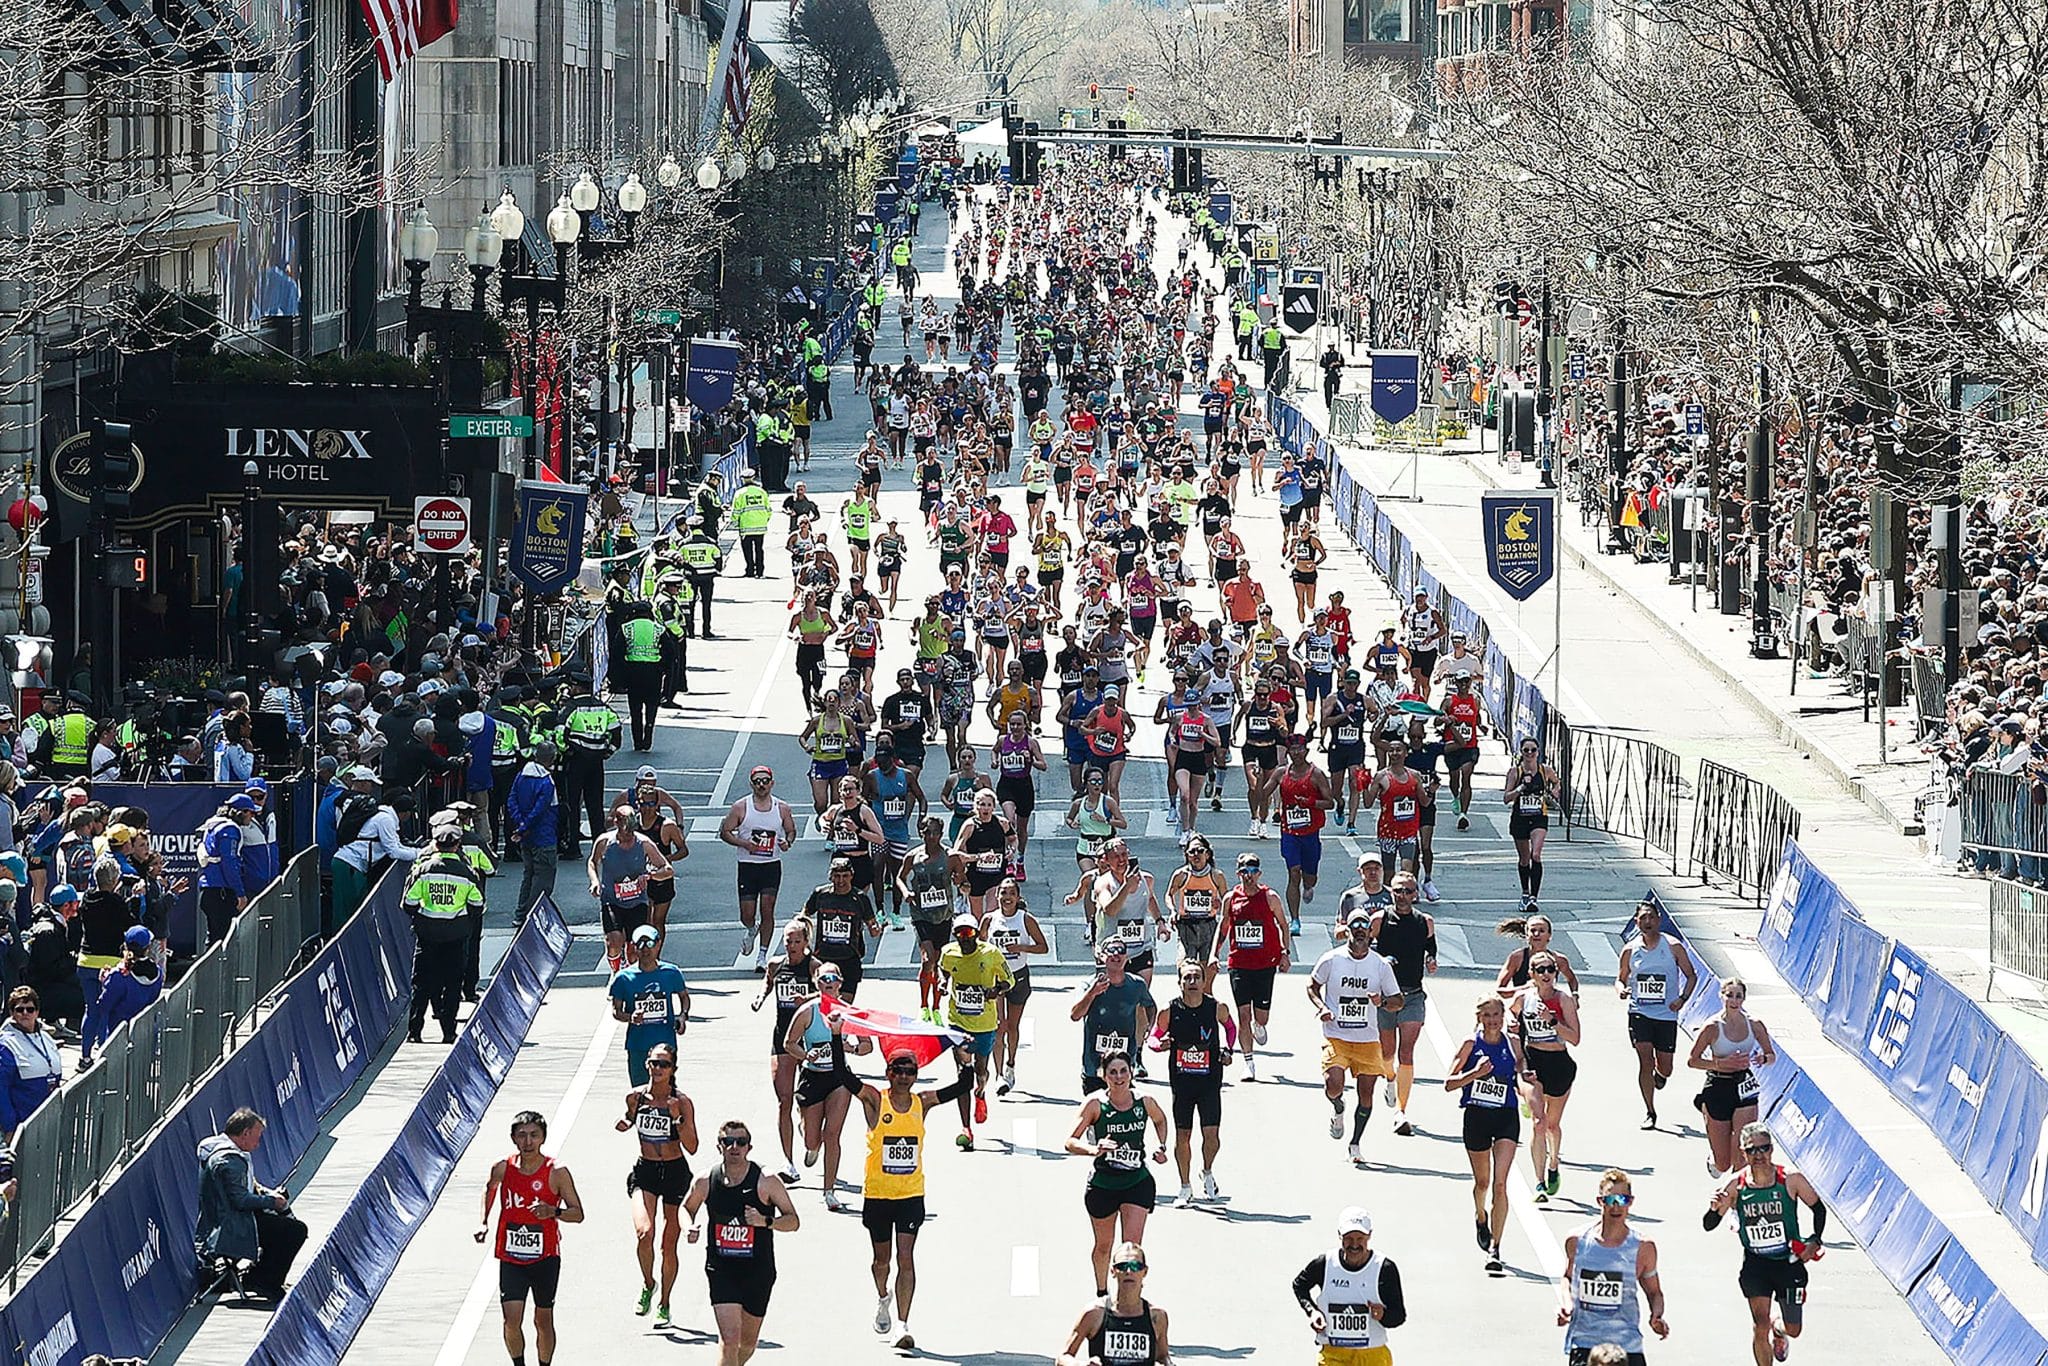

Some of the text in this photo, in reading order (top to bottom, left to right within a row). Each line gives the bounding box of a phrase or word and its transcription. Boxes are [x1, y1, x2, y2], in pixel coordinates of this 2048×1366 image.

[467, 420, 523, 436] EXETER ST
[268, 464, 330, 482] HOTEL
[424, 510, 461, 520] DO NOT
[427, 531, 457, 540] ENTER
[528, 535, 568, 548] BOSTON
[526, 545, 567, 554] MARATHON
[1498, 543, 1538, 553] BOSTON
[1498, 552, 1538, 560] MARATHON
[135, 557, 146, 582] 9
[429, 883, 457, 894] BOSTON
[431, 894, 455, 905] POLICE
[1236, 926, 1260, 937] 11232
[1640, 982, 1664, 993] 11632
[637, 1000, 665, 1012] 12829
[1341, 1005, 1366, 1017] 16641
[1101, 1036, 1124, 1048] 9199
[1182, 1050, 1205, 1063] 4952
[1475, 1081, 1505, 1098] 10949
[637, 1114, 668, 1131] 13752
[1106, 1120, 1145, 1134] IRELAND
[889, 1146, 914, 1160] 8638
[1743, 1200, 1783, 1217] MEXICO
[720, 1227, 749, 1242] 4202
[1750, 1224, 1782, 1241] 11225
[509, 1232, 541, 1248] 12054
[1583, 1281, 1619, 1297] 11226
[1331, 1315, 1368, 1331] 13008
[1110, 1333, 1147, 1351] 13138
